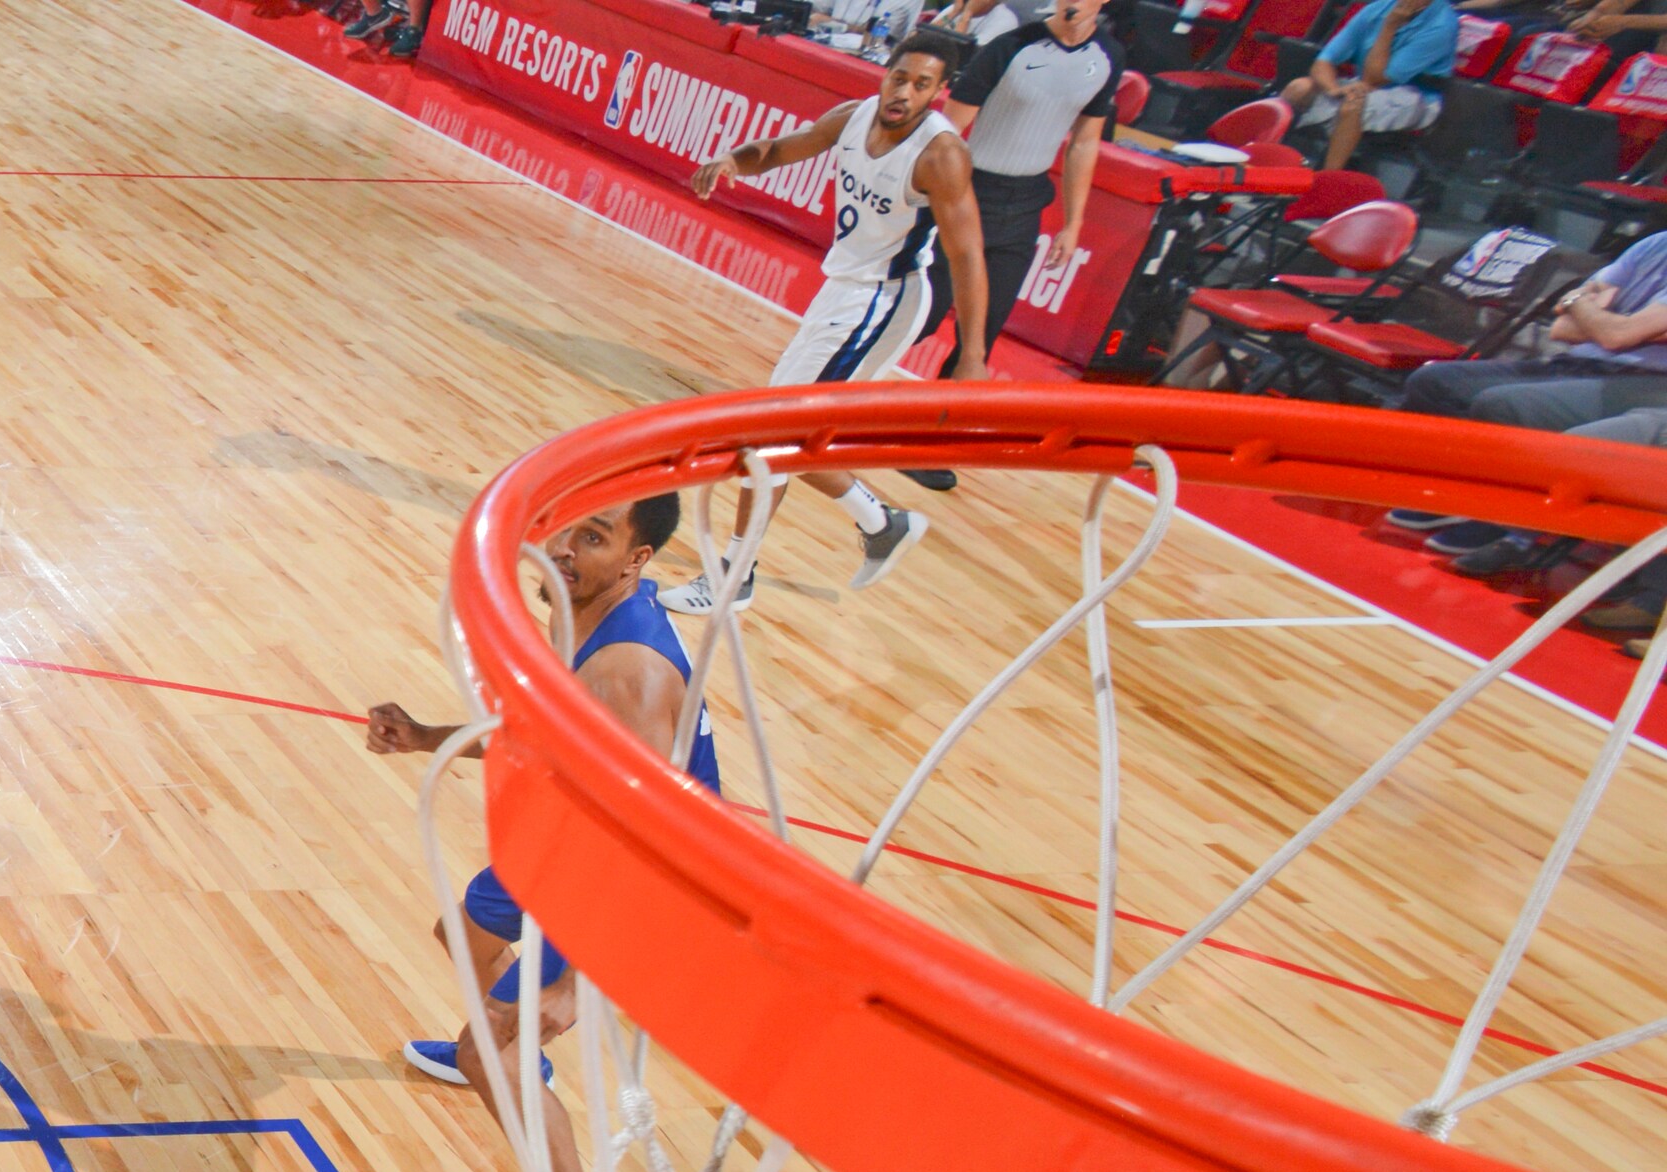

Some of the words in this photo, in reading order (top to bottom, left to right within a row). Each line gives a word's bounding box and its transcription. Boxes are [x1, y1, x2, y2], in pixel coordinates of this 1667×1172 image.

[443, 0, 500, 56] MGM
[496, 16, 607, 103] RESORTS
[629, 61, 750, 167] SUMMER
[836, 204, 859, 241] 9
